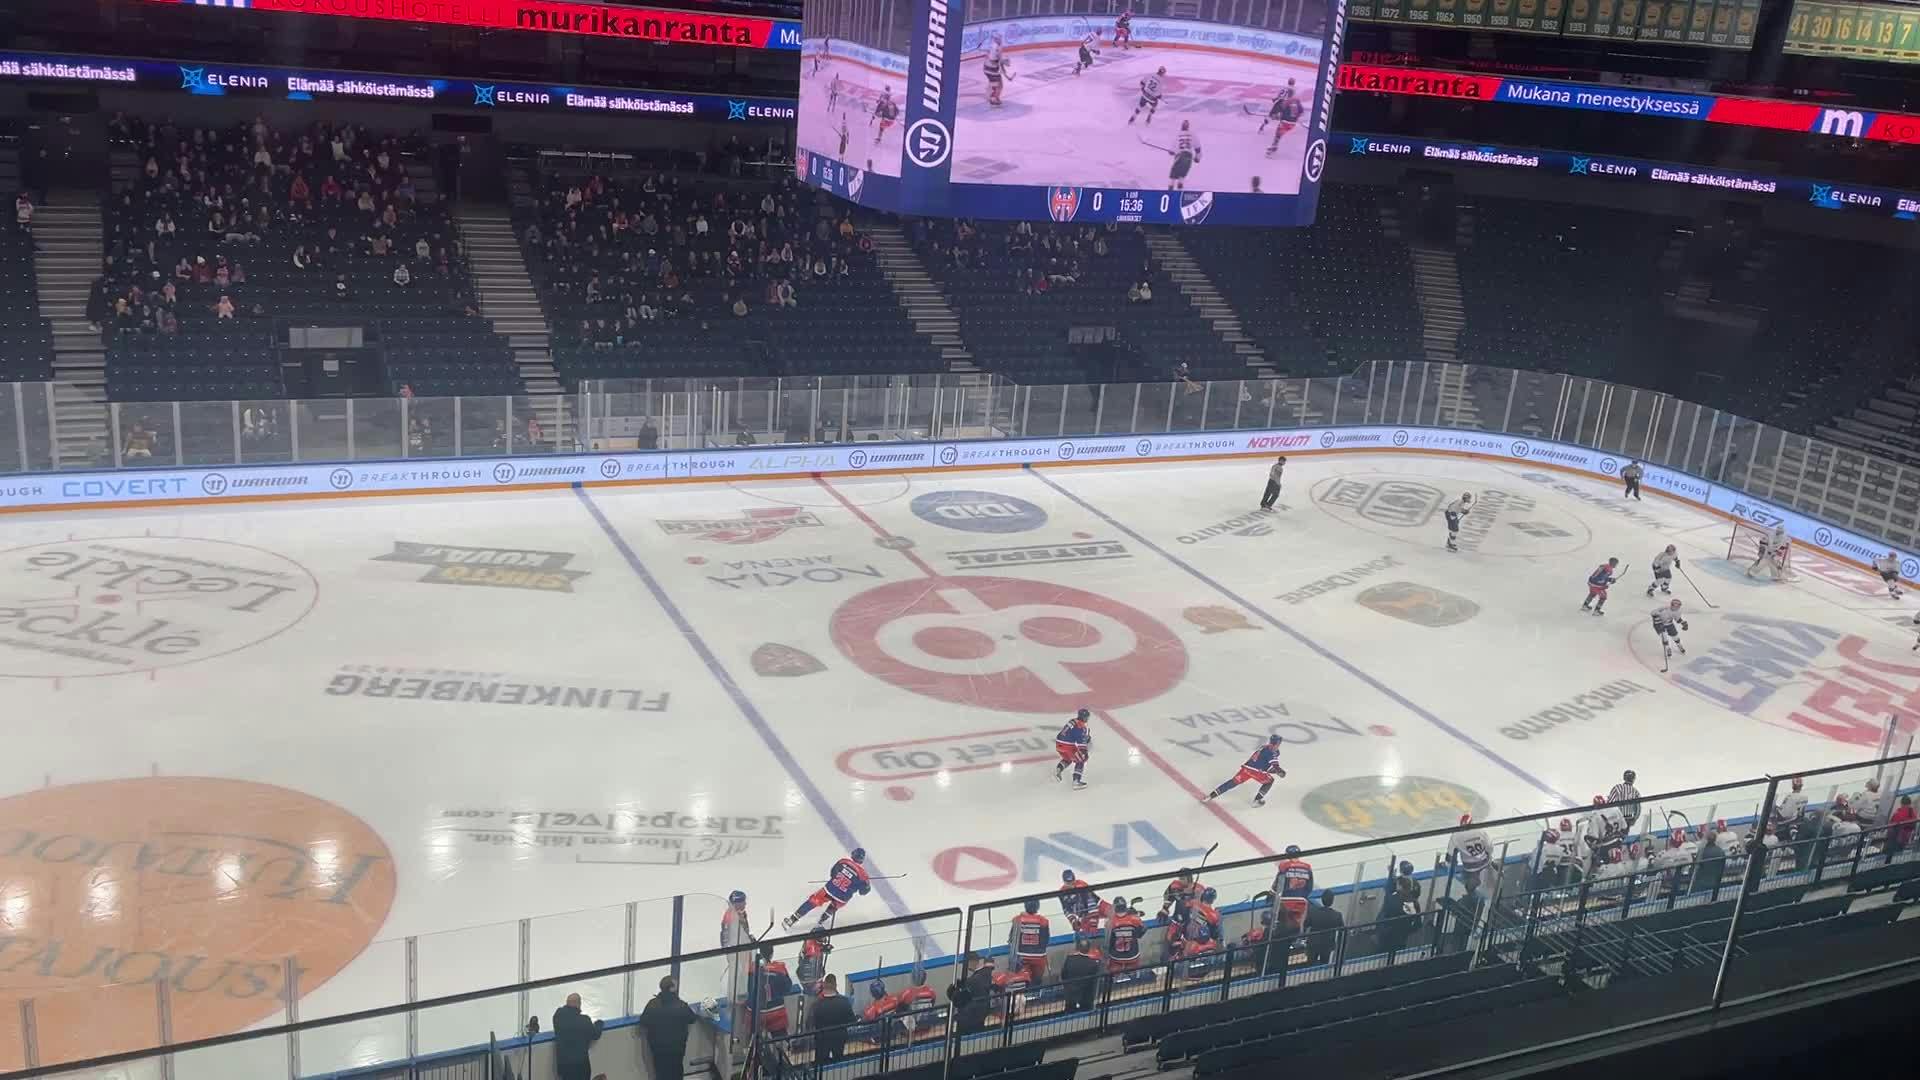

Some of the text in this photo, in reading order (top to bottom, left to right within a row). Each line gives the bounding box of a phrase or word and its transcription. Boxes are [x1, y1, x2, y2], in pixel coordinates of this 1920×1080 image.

[516, 6, 752, 45] murikanranta
[1812, 16, 1832, 38] 30
[1836, 17, 1852, 39] 16
[1856, 19, 1872, 41] 14
[1878, 22, 1893, 44] 13
[1900, 24, 1912, 44] 7
[22, 63, 136, 82] sähköistämässä
[207, 74, 268, 88] ELENIA
[288, 77, 334, 93] Elämää
[336, 80, 434, 99] sähköistämässä
[497, 91, 549, 104] ELENIA
[567, 93, 607, 109] Elämää
[609, 97, 693, 114] sähköistämässä
[748, 106, 794, 119] ELENIA
[1508, 84, 1570, 103] Mukana
[1577, 91, 1700, 116] menestyksessä
[1369, 142, 1411, 154] ELENIA
[1424, 146, 1460, 160] Elämää
[1461, 149, 1539, 167] sähköistämässä
[1590, 163, 1637, 177] ELENIA
[1651, 168, 1690, 184] Elämää
[1691, 172, 1776, 193] sähköistämässä
[1831, 190, 1882, 207] ELENIA
[1093, 192, 1102, 211] 0
[1119, 199, 1143, 212] 15:36
[1160, 194, 1169, 213] 0
[62, 478, 187, 498] COVERT
[360, 470, 482, 483] BREAKTHROUGH
[626, 460, 735, 472] BREAKTHROUGH
[749, 455, 838, 470] ALPHA
[962, 448, 1050, 459] BREAKTHROUGH
[1155, 440, 1235, 451] BREAKTHROUGH
[1247, 434, 1312, 449] NOVIUM
[1412, 434, 1502, 449] BREAKTHROUGH
[723, 555, 833, 570] ARENA
[324, 673, 672, 713] FLINKENBERG
[1171, 702, 1292, 728] ARENA
[872, 749, 943, 771] Oy
